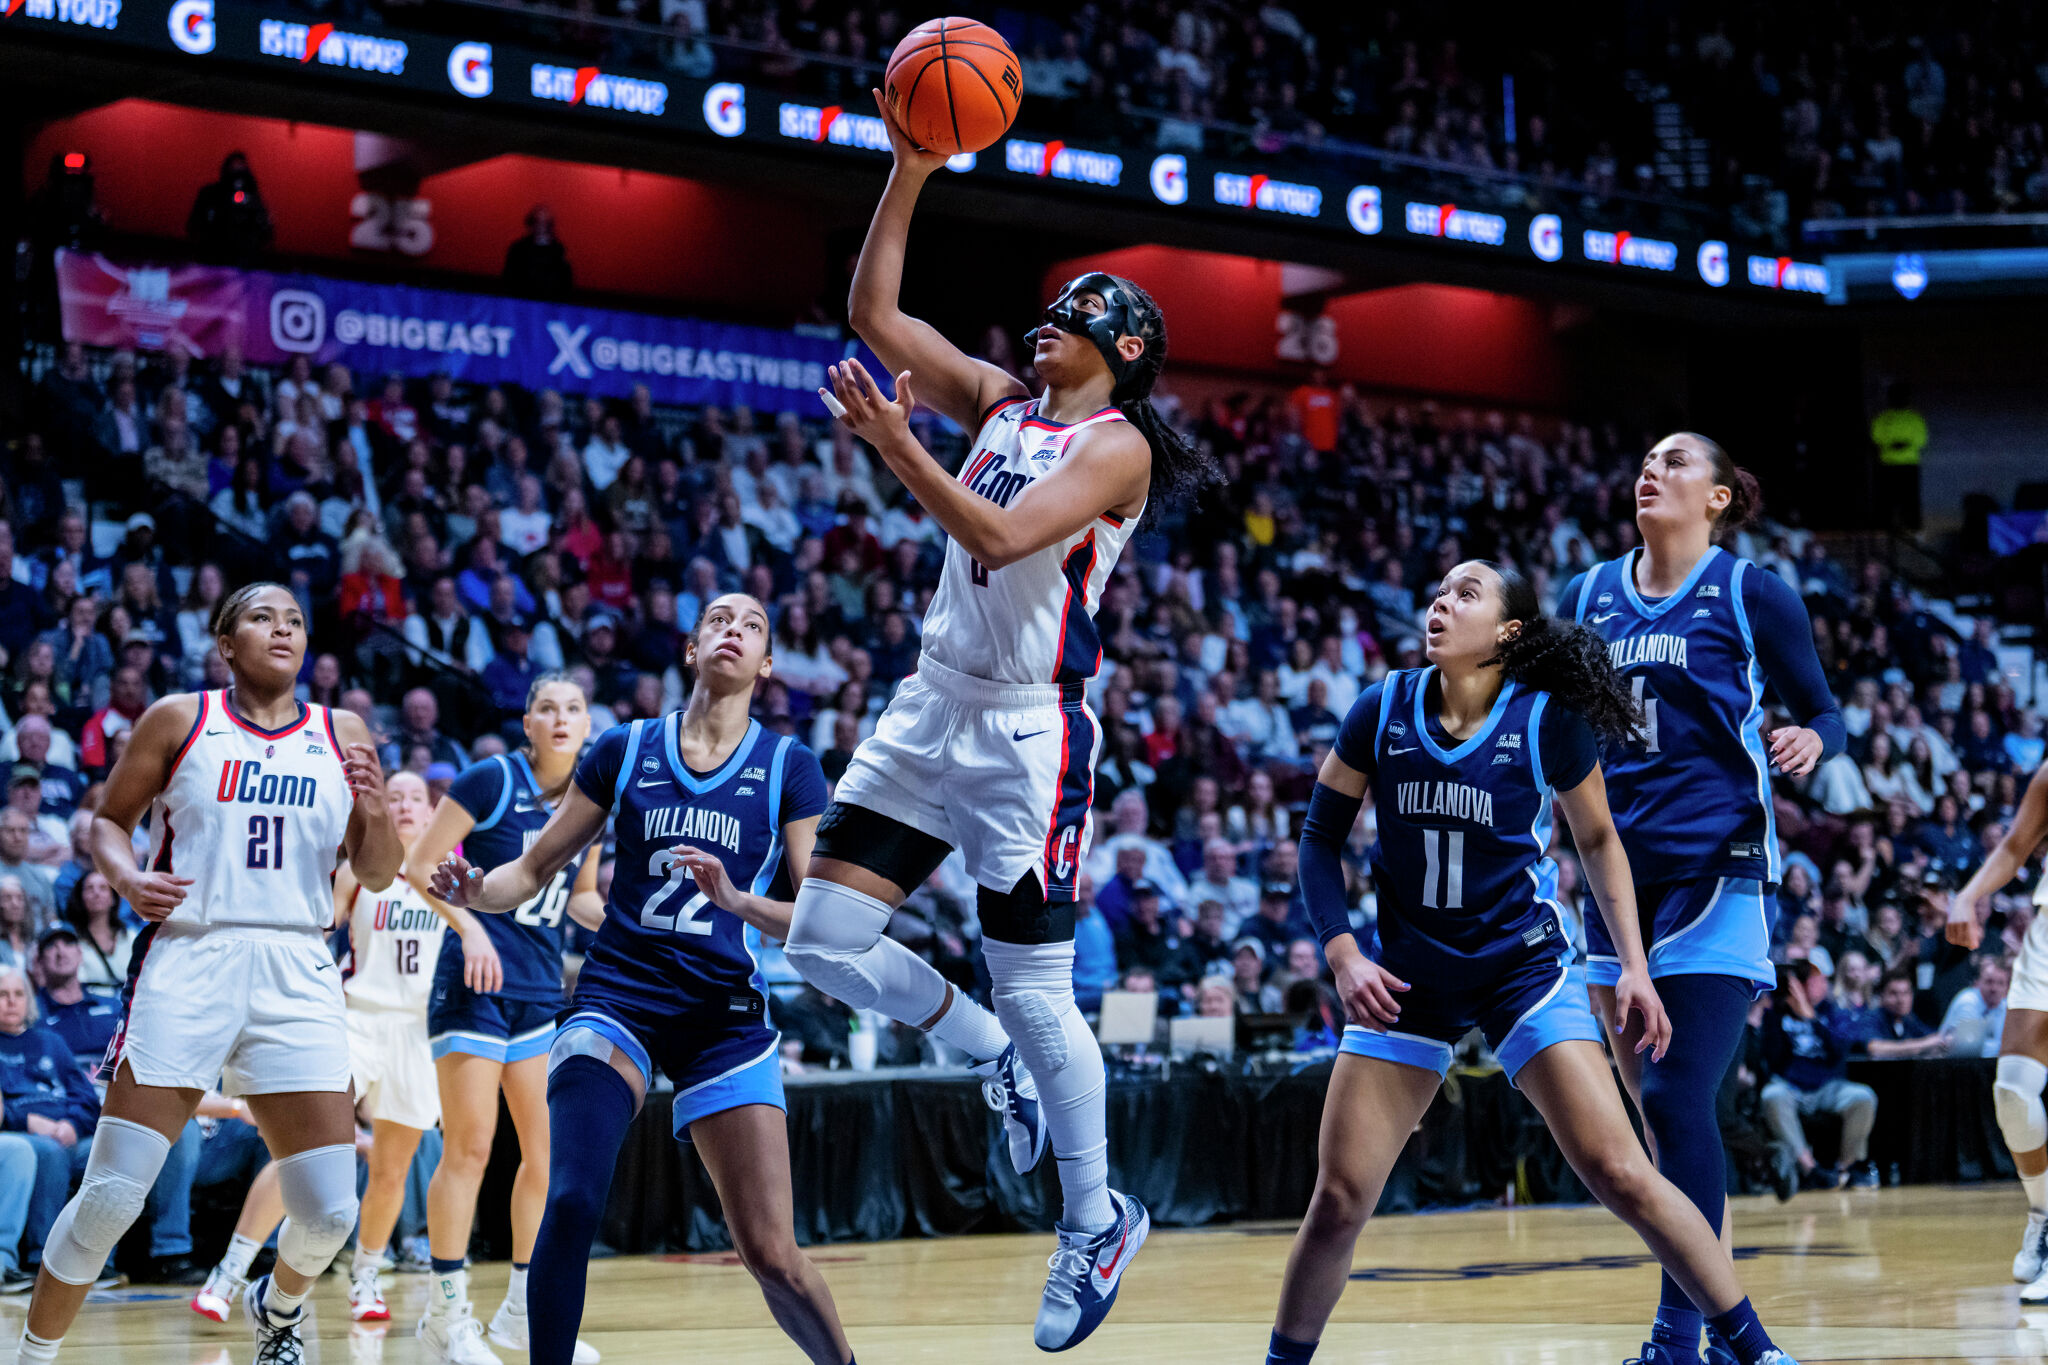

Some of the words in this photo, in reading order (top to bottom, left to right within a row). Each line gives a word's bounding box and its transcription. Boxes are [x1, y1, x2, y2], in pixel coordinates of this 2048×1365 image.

[168, 0, 216, 54] G
[448, 41, 493, 98] G
[703, 82, 745, 137] G
[1150, 154, 1188, 205] G
[352, 193, 432, 254] 25
[1347, 185, 1382, 235] G
[1529, 213, 1563, 262] G
[1697, 240, 1729, 287] G
[335, 310, 515, 357] @BIGEAST
[1496, 740, 1521, 748] CHANGE
[216, 759, 317, 808] UConn
[740, 773, 765, 781] CHANGE
[1397, 780, 1494, 828] VILLANOVA
[246, 815, 284, 870] 21
[644, 807, 741, 854] VILLANOVA
[1752, 847, 1760, 855] XL
[641, 849, 713, 936] 22
[1422, 828, 1464, 909] 11
[373, 900, 440, 931] UConn
[396, 939, 419, 975] 12
